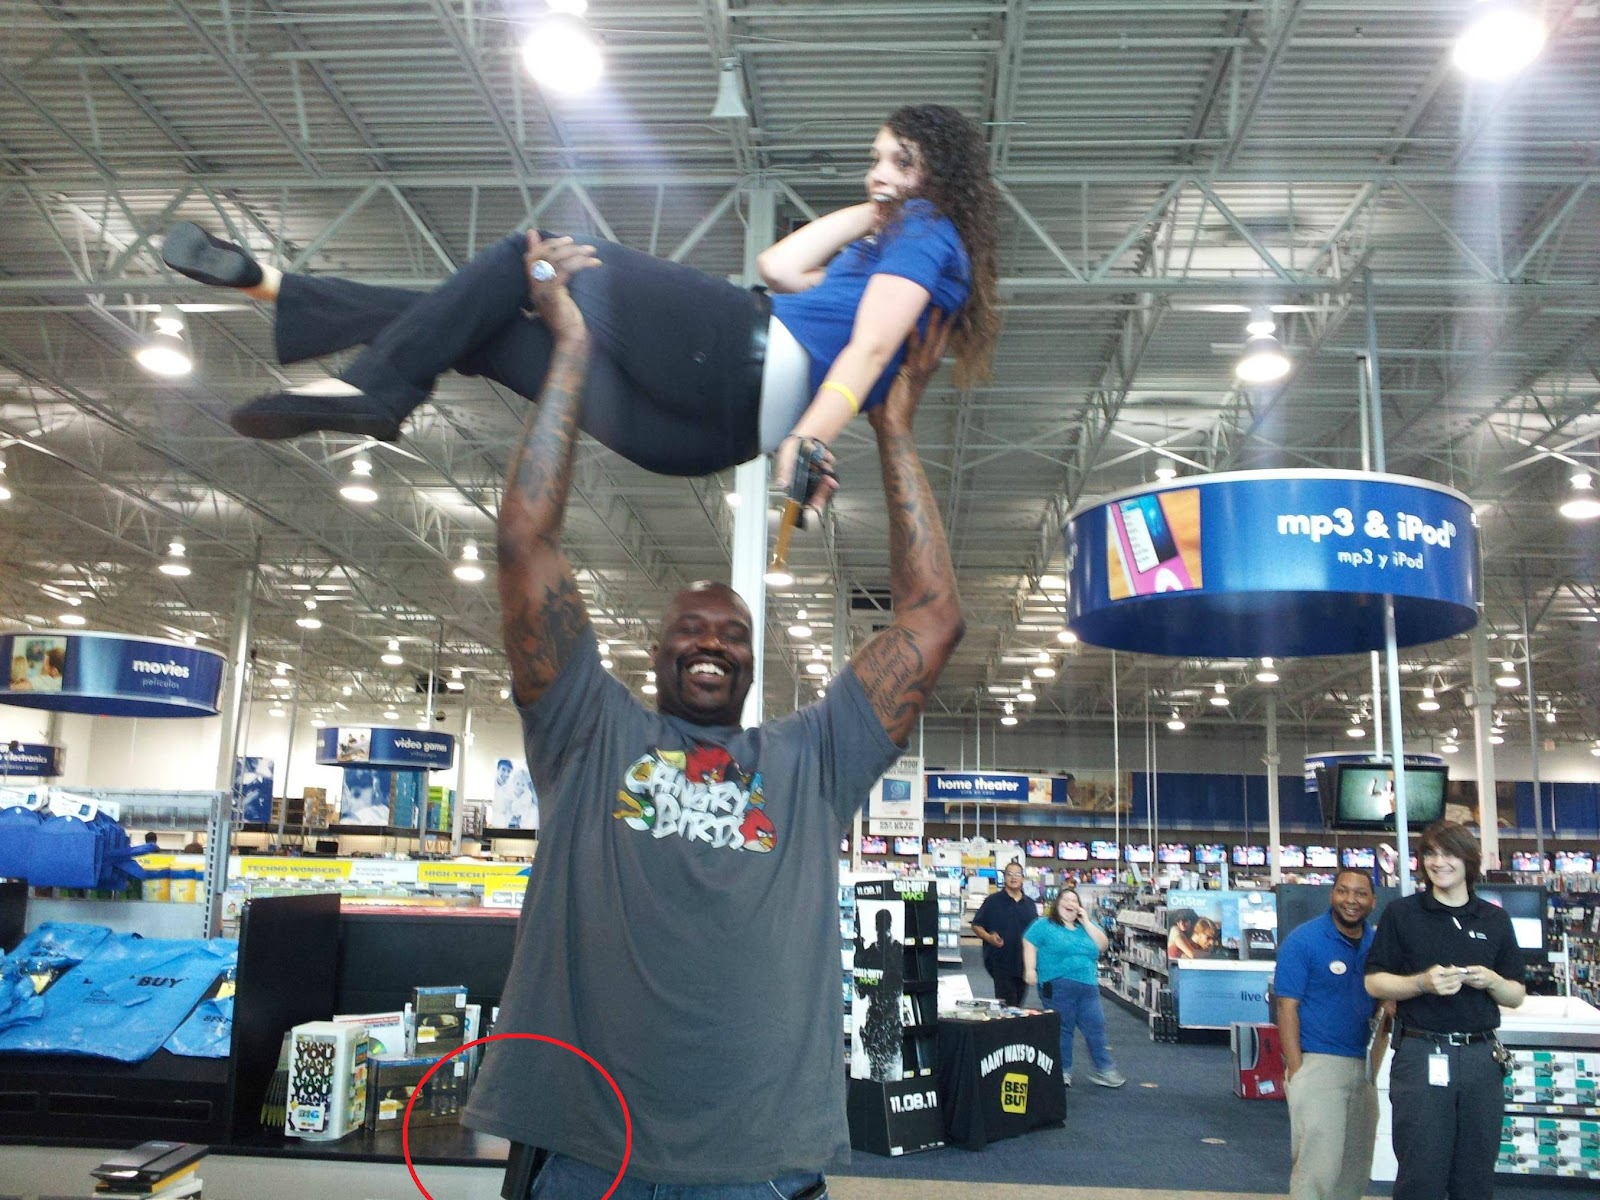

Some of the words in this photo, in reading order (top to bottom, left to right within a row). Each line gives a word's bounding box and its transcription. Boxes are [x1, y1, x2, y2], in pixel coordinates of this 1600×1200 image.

[1276, 507, 1355, 543] mp3
[1364, 509, 1391, 539] &
[1337, 548, 1373, 567] mp3
[1377, 553, 1389, 569] y
[1392, 551, 1424, 570] iPod
[132, 660, 190, 679] movies
[393, 737, 422, 750] video
[422, 741, 448, 753] games
[4, 752, 48, 764] electronics
[650, 761, 750, 816] ANGRY
[937, 776, 972, 790] home
[974, 777, 1019, 791] theater
[651, 793, 746, 851] BIRDS
[247, 865, 288, 873] TECHNO
[290, 866, 342, 874] WONDERS
[856, 884, 882, 896] 11.08.11
[901, 891, 925, 901] MW3
[1170, 896, 1207, 906] OnStar
[137, 976, 184, 988] BUY
[1240, 990, 1262, 1002] live
[980, 1048, 1004, 1078] MANY
[1004, 1044, 1026, 1063] WAYS
[1004, 1081, 1028, 1094] BEST
[890, 1090, 938, 1114] 11.08.11
[1004, 1094, 1026, 1107] BUY
